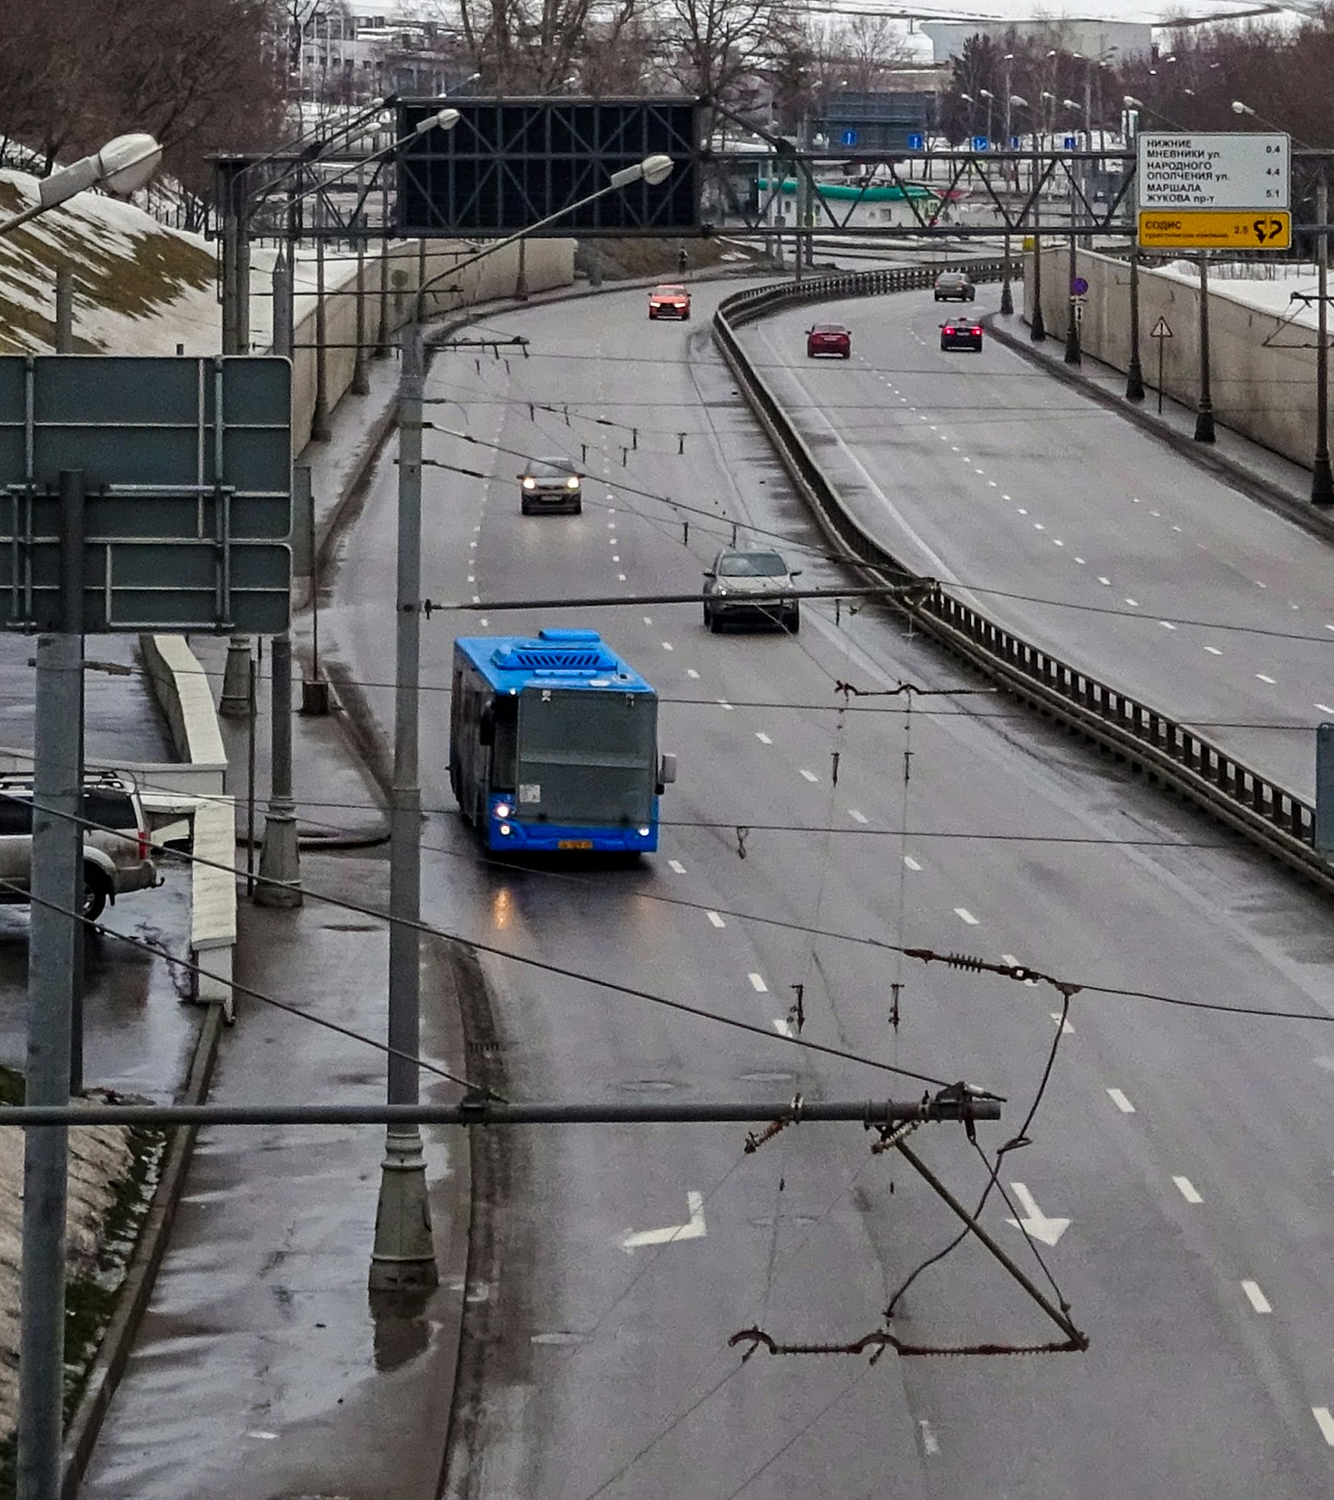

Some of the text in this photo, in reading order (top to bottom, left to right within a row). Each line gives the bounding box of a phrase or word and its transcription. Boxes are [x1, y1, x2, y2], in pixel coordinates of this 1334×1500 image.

[1147, 140, 1191, 148] НИЖНИЕ
[1266, 145, 1280, 154] 0.4
[1147, 150, 1221, 160] МНЕВНИКИ ул.
[1147, 161, 1212, 171] НАРОДНОГО
[1266, 168, 1280, 176] 4.4
[1147, 172, 1230, 182] ОПОЛЧЕНИЯ ул.
[1147, 183, 1202, 192] МАРШАЛА
[1266, 189, 1280, 198] 5.1
[1147, 194, 1214, 204] ЖУКОВА пр-т
[1145, 221, 1182, 230] СОДИС
